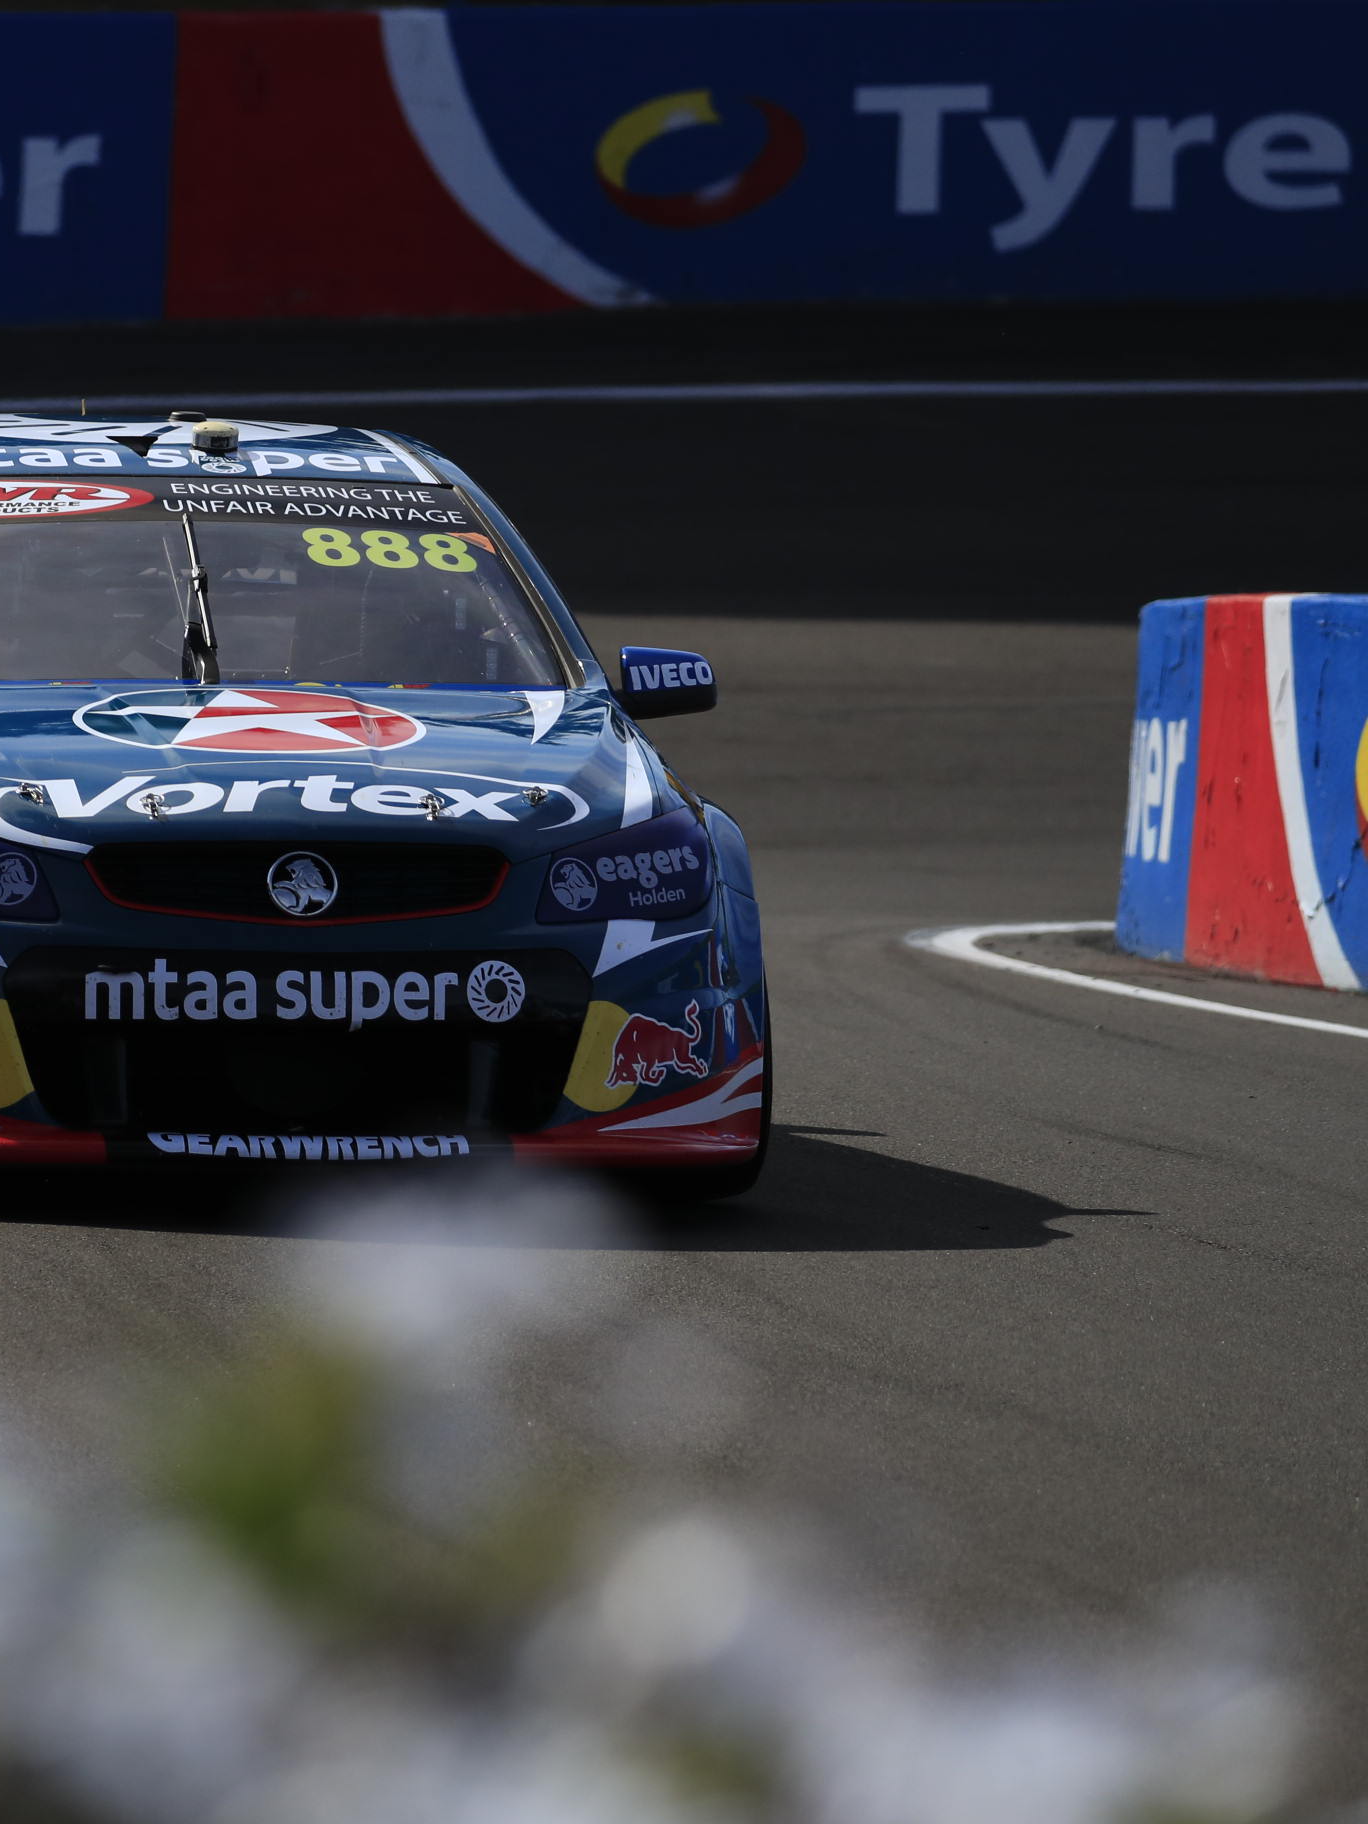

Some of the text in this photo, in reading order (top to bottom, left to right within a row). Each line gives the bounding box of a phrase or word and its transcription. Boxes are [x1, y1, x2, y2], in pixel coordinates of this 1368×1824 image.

[854, 83, 1353, 252] Tyre
[145, 448, 398, 477] sper
[170, 482, 436, 504] ENGINEERING THE
[163, 499, 468, 525] UNFAIR ADVANTAGE
[302, 527, 478, 573] 888
[629, 661, 713, 691] IVECO
[37, 774, 520, 823] Vortex
[596, 845, 700, 889] eagers
[628, 887, 687, 907] Holden
[85, 959, 459, 1033] mtaa super
[146, 1131, 470, 1161] GEARWRENCH
